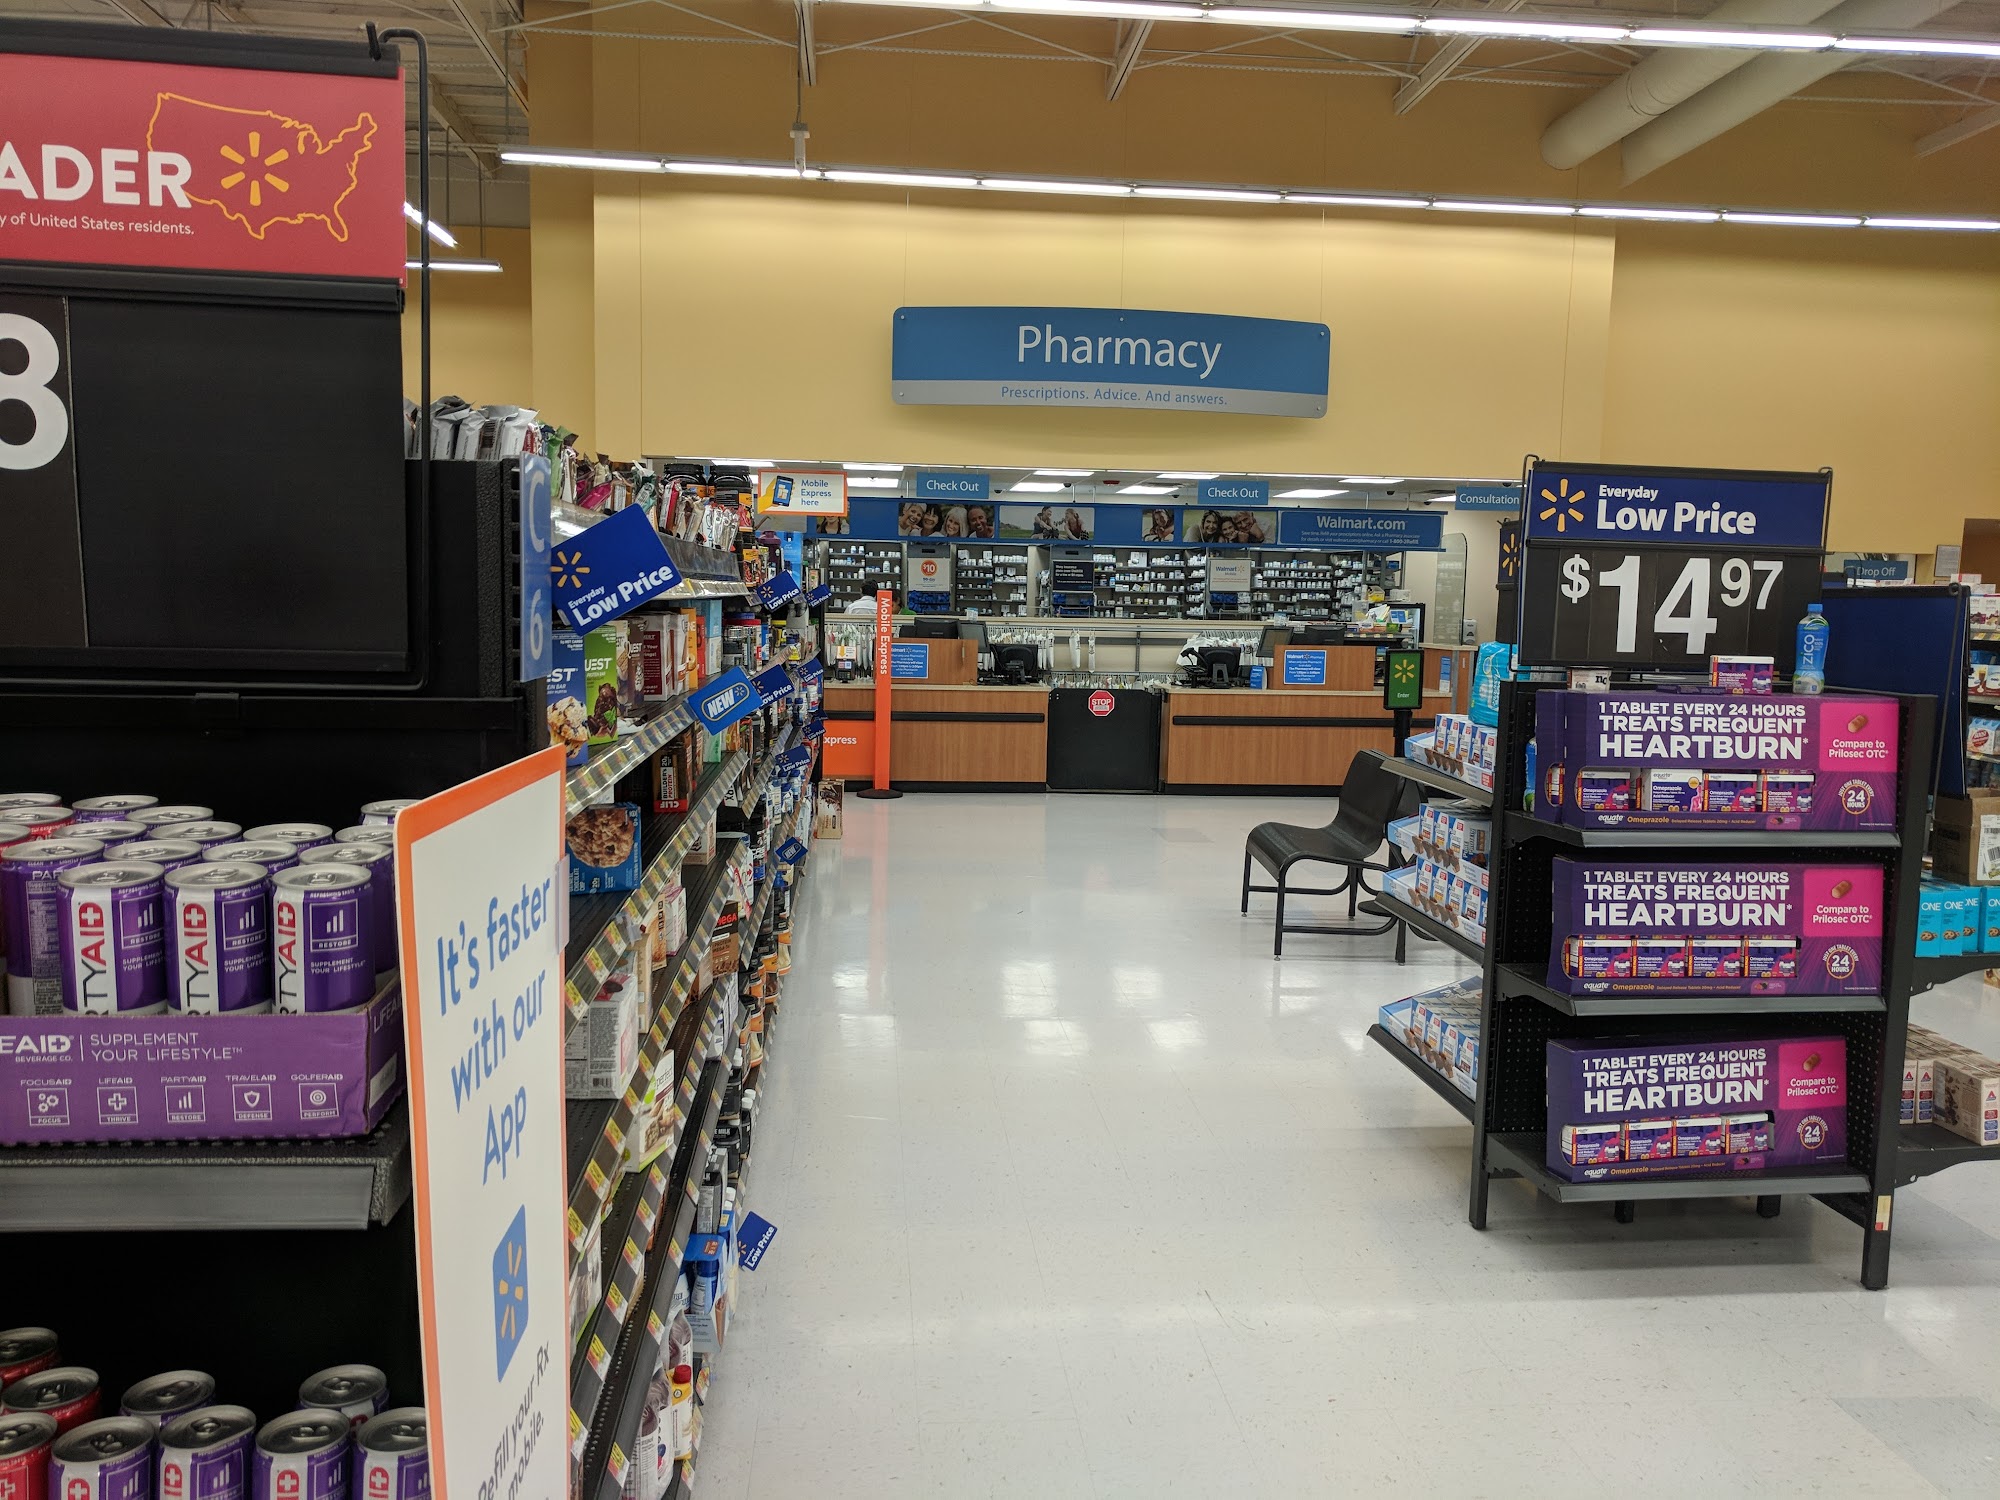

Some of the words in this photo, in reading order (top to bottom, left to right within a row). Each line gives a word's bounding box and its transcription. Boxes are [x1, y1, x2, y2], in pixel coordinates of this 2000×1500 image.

[0, 140, 192, 208] ADER
[11, 212, 26, 226] of
[30, 213, 77, 229] United
[81, 216, 125, 232] States
[128, 220, 195, 236] residents.
[1018, 324, 1222, 379] Pharmacy
[0, 313, 68, 470] 8
[1001, 386, 1089, 400] Prescriptions.
[1094, 387, 1140, 401] Advice.
[1145, 389, 1171, 402] And
[1175, 391, 1227, 405] answers.
[801, 479, 829, 488] Mobile
[926, 479, 958, 491] Check
[960, 480, 979, 491] Out
[801, 489, 832, 499] Express
[1207, 487, 1238, 499] Check
[1240, 487, 1259, 498] Out
[1459, 493, 1520, 505] Consultation
[1599, 484, 1659, 501] Everyday
[801, 498, 819, 506] here
[528, 470, 545, 552] C
[1597, 499, 1667, 531] Low
[1674, 501, 1756, 534] Price
[1316, 515, 1406, 530] Walmart.com
[1856, 566, 1879, 579] Drop
[1881, 566, 1896, 577] Off
[568, 585, 605, 609] Everyday
[572, 590, 619, 627] Low
[617, 566, 674, 602] Price
[768, 598, 783, 611] Low
[782, 587, 800, 602] Price
[880, 597, 891, 633] Mobile
[530, 589, 543, 660] 6
[878, 636, 890, 674] Express
[804, 673, 814, 683] Low
[813, 668, 824, 680] Price
[773, 684, 792, 698] Price
[706, 688, 736, 718] NEW
[1091, 698, 1112, 706] STOP
[1599, 702, 1606, 713] 1
[1609, 702, 1669, 715] TABLET
[1673, 703, 1724, 715] EVERY
[1728, 703, 1749, 716] 24
[1752, 704, 1805, 717] HOURS
[1599, 715, 1684, 733] TREATS
[1689, 716, 1806, 736] FREQUENT
[1832, 739, 1871, 751] Compare
[1873, 740, 1885, 749] to
[1828, 749, 1864, 760] Prilosec
[783, 764, 796, 773] Low
[795, 757, 811, 769] Price
[1847, 790, 1865, 802] 24
[660, 800, 680, 809] CLIF
[1598, 813, 1624, 823] equate
[1627, 815, 1669, 824] Omeprazole
[784, 845, 797, 860] NEW
[1583, 871, 1590, 883] 1
[1593, 871, 1651, 883] TABLET
[1657, 871, 1707, 884] EVERY
[1712, 871, 1731, 883] 24
[1735, 871, 1789, 884] HOURS
[1584, 884, 1667, 900] TREATS
[1673, 884, 1790, 903] FREQUENT
[1816, 904, 1855, 917] Compare
[1857, 905, 1869, 914] to
[1921, 902, 1941, 911] ONE
[1943, 901, 1964, 910] ONE
[1812, 914, 1848, 924] Prilosec
[130, 932, 161, 945] RESTORE
[232, 934, 262, 946] RESTORE
[318, 939, 352, 949] RESTORE
[438, 920, 480, 1016] It's
[486, 877, 551, 971] faster
[224, 952, 264, 966] SUPPLEMENT
[310, 957, 354, 968] SUPPLEMENT
[1832, 955, 1850, 967] 24
[122, 962, 143, 972] YOUR
[224, 964, 244, 973] YOUR
[1583, 981, 1609, 991] equate
[1612, 983, 1655, 991] Omeprazole
[90, 1032, 199, 1047] SUPPLEMENT
[450, 998, 506, 1114] with
[513, 969, 546, 1042] our
[15, 1055, 57, 1063] BEVERAGE
[90, 1049, 138, 1062] YOUR
[1582, 1059, 1589, 1070] 1
[1592, 1056, 1646, 1070] TABLET
[1649, 1053, 1695, 1067] EVERY
[1698, 1052, 1715, 1064] 24
[1718, 1048, 1766, 1062] HOURS
[160, 1075, 207, 1084] PARTYAID
[225, 1073, 277, 1082] TRAVELAID
[290, 1073, 344, 1081] GOLFERAID
[1583, 1068, 1659, 1088] TREATS
[1664, 1060, 1766, 1082] FREQUENT
[20, 1078, 73, 1086] FOCUSAID
[98, 1077, 133, 1085] LIFEAID
[1790, 1077, 1825, 1088] Compare
[1828, 1076, 1836, 1085] to
[1786, 1086, 1819, 1097] Prilosec
[238, 1112, 269, 1120] DEFENSE
[303, 1110, 336, 1119] PERFORM
[483, 1085, 528, 1185] App
[718, 1127, 731, 1136] MILK
[1804, 1125, 1821, 1138] 24
[1584, 1167, 1608, 1178] equate
[1610, 1166, 1649, 1175] Omeprazole
[747, 1248, 762, 1267] Low
[758, 1226, 774, 1249] Price
[511, 1374, 535, 1458] your
[537, 1339, 550, 1386] Rx
